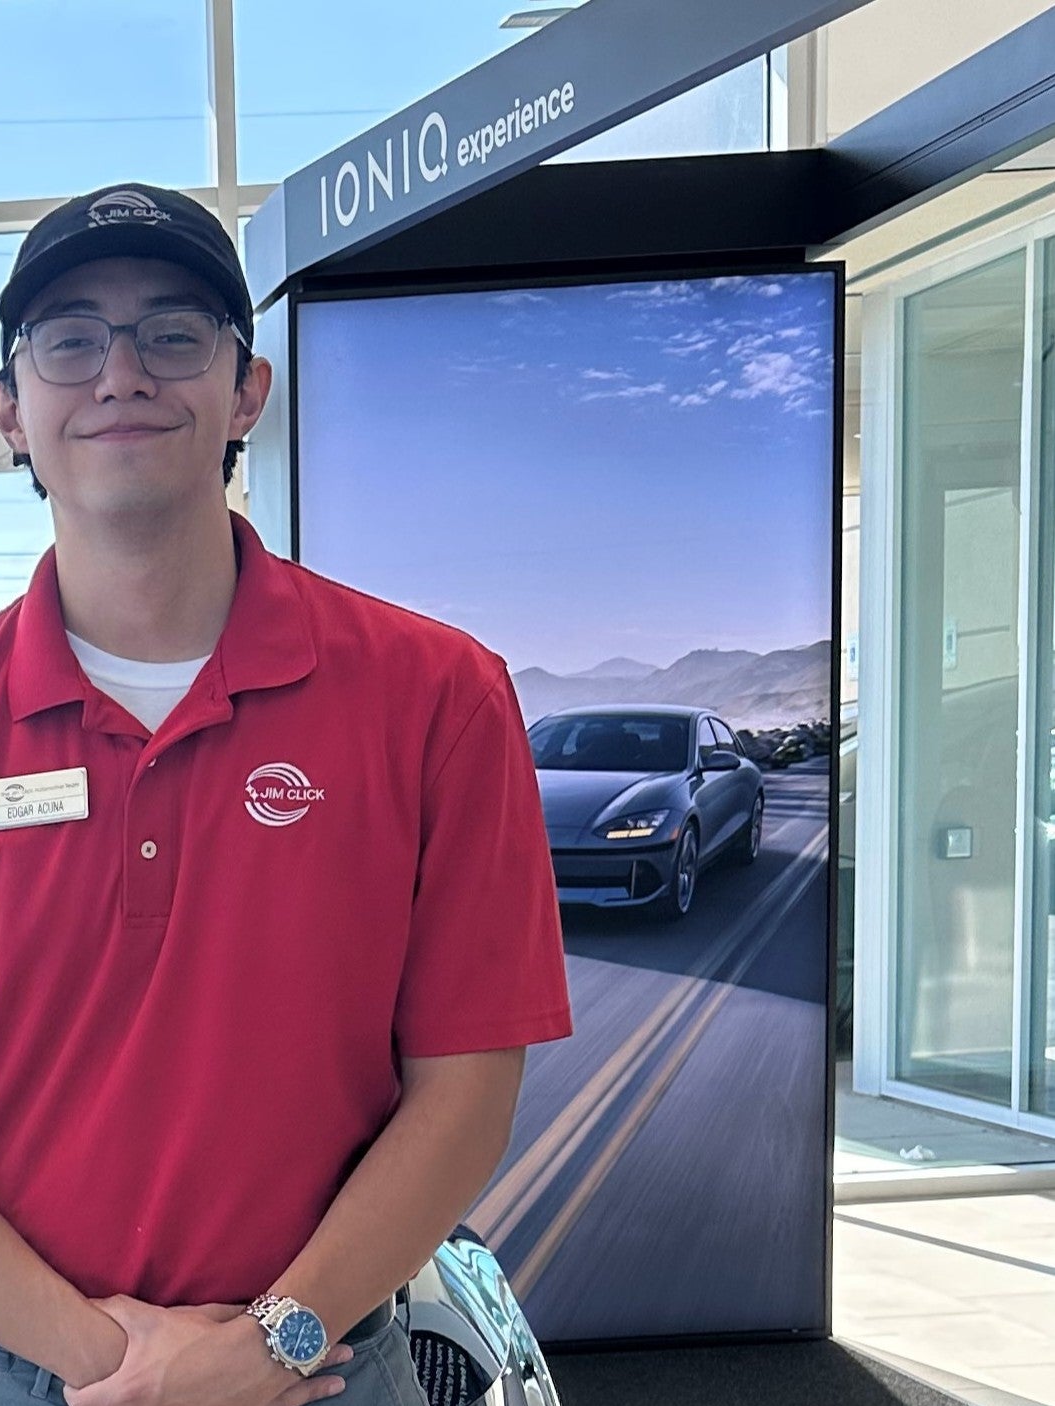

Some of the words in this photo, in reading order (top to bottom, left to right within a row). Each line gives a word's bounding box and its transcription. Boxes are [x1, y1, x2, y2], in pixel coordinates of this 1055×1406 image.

[320, 111, 448, 237] IONIQ
[457, 81, 575, 166] experience
[104, 209, 130, 219] JIM
[133, 208, 172, 221] CLICK
[259, 787, 284, 800] JIM
[286, 788, 325, 801] CLICK
[7, 804, 34, 819] EDGAR
[37, 801, 64, 815] ACUNA
